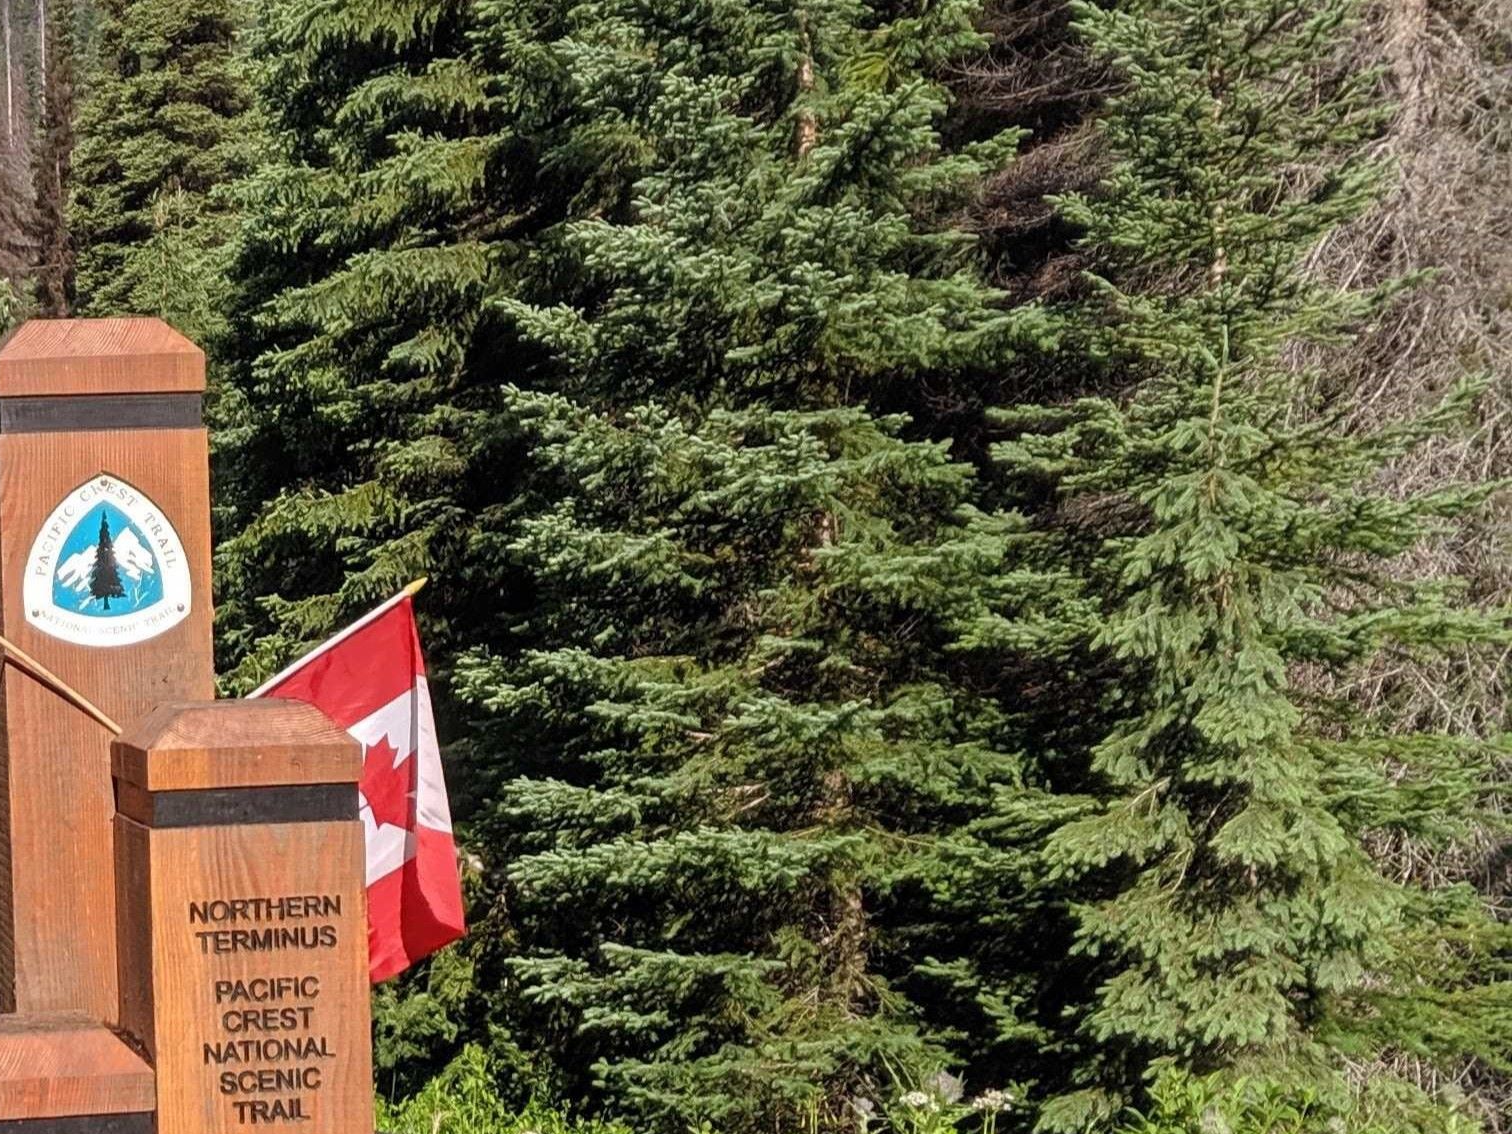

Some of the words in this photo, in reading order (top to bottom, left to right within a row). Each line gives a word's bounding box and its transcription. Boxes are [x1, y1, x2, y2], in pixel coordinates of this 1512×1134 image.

[35, 504, 76, 577] PACIFIC
[80, 481, 139, 508] CREST
[144, 511, 178, 569] TRAIL
[189, 895, 341, 924] NORTHERN
[195, 925, 337, 954] TERMINUS
[215, 976, 320, 1004] PACIFIC
[222, 1006, 314, 1033] CREST
[203, 1037, 336, 1065] NATIONAL
[220, 1067, 322, 1095] SCENIC
[232, 1098, 311, 1124] TRAIL
